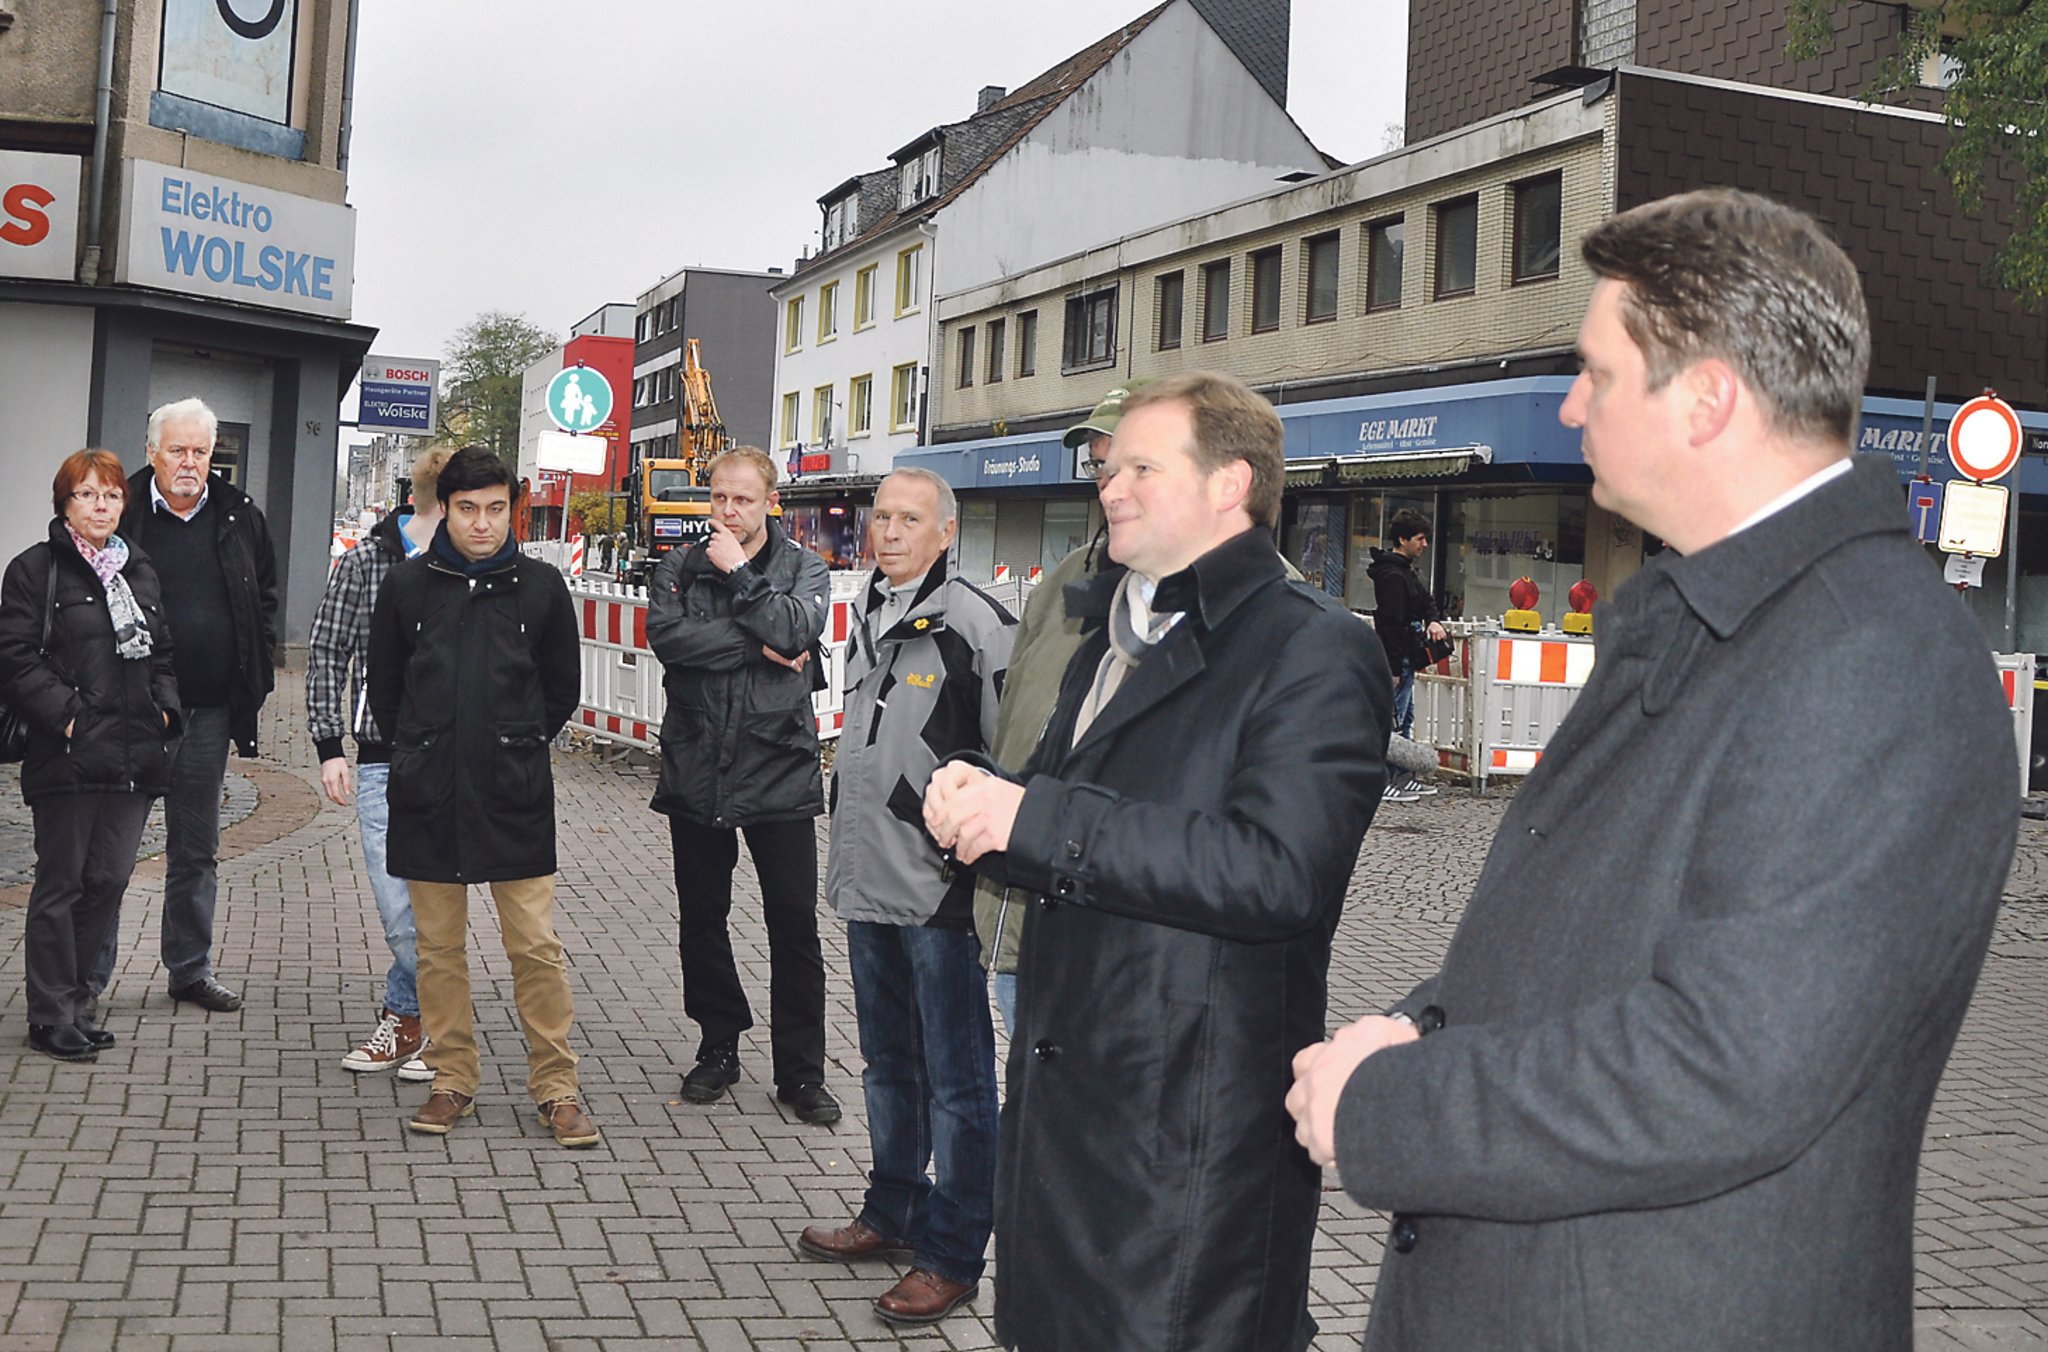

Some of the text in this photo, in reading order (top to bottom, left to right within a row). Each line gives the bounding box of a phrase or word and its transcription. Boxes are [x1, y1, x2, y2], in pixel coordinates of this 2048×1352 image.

[161, 176, 273, 233] Elektro
[160, 226, 335, 301] WOLSKE
[385, 368, 429, 381] BOSCH
[364, 386, 428, 396] Hausgeräte Partner
[363, 400, 388, 409] ELEKTRO
[1359, 416, 1438, 441] EGE MARKT
